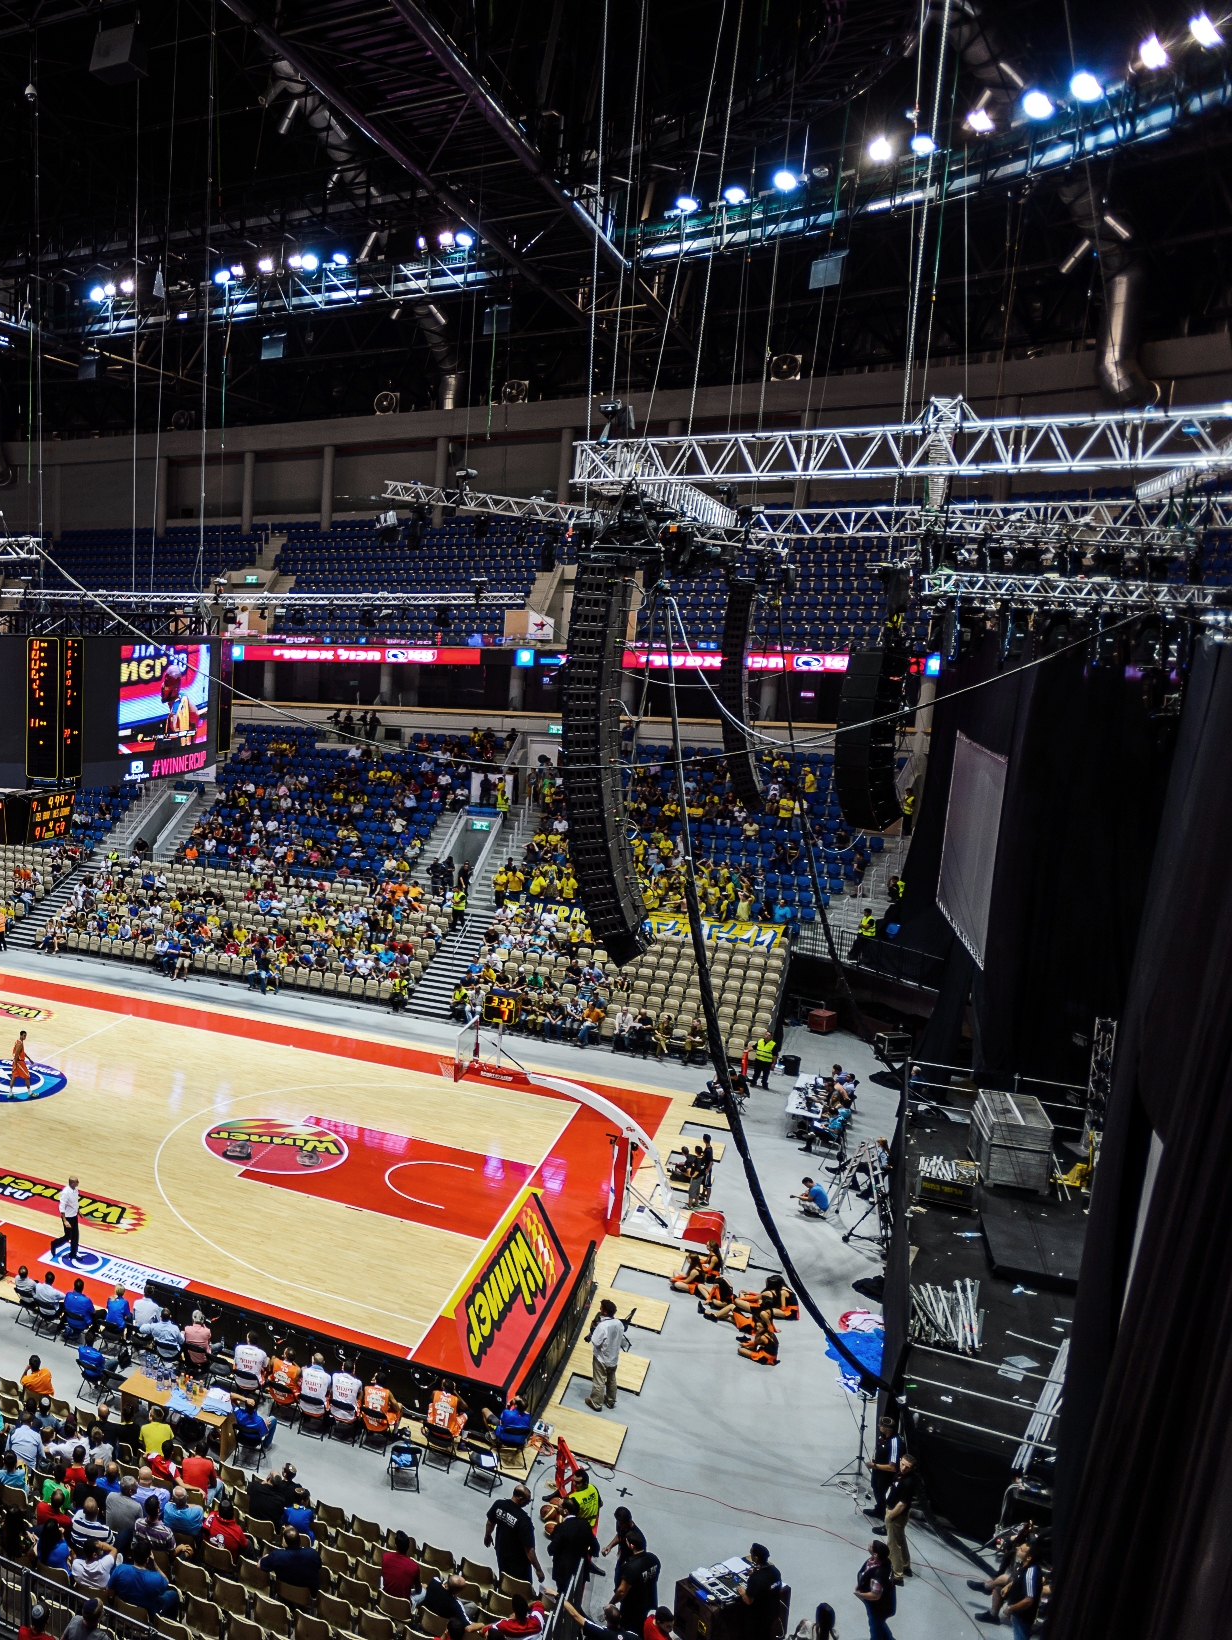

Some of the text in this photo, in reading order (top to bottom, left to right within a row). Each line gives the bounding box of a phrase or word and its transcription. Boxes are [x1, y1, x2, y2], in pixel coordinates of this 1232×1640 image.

[272, 649, 336, 661] אפשרי
[151, 750, 207, 778] #WINNERCUP
[210, 1131, 340, 1154] Winner
[468, 1231, 544, 1356] Winner
[435, 1410, 450, 1427] 21
